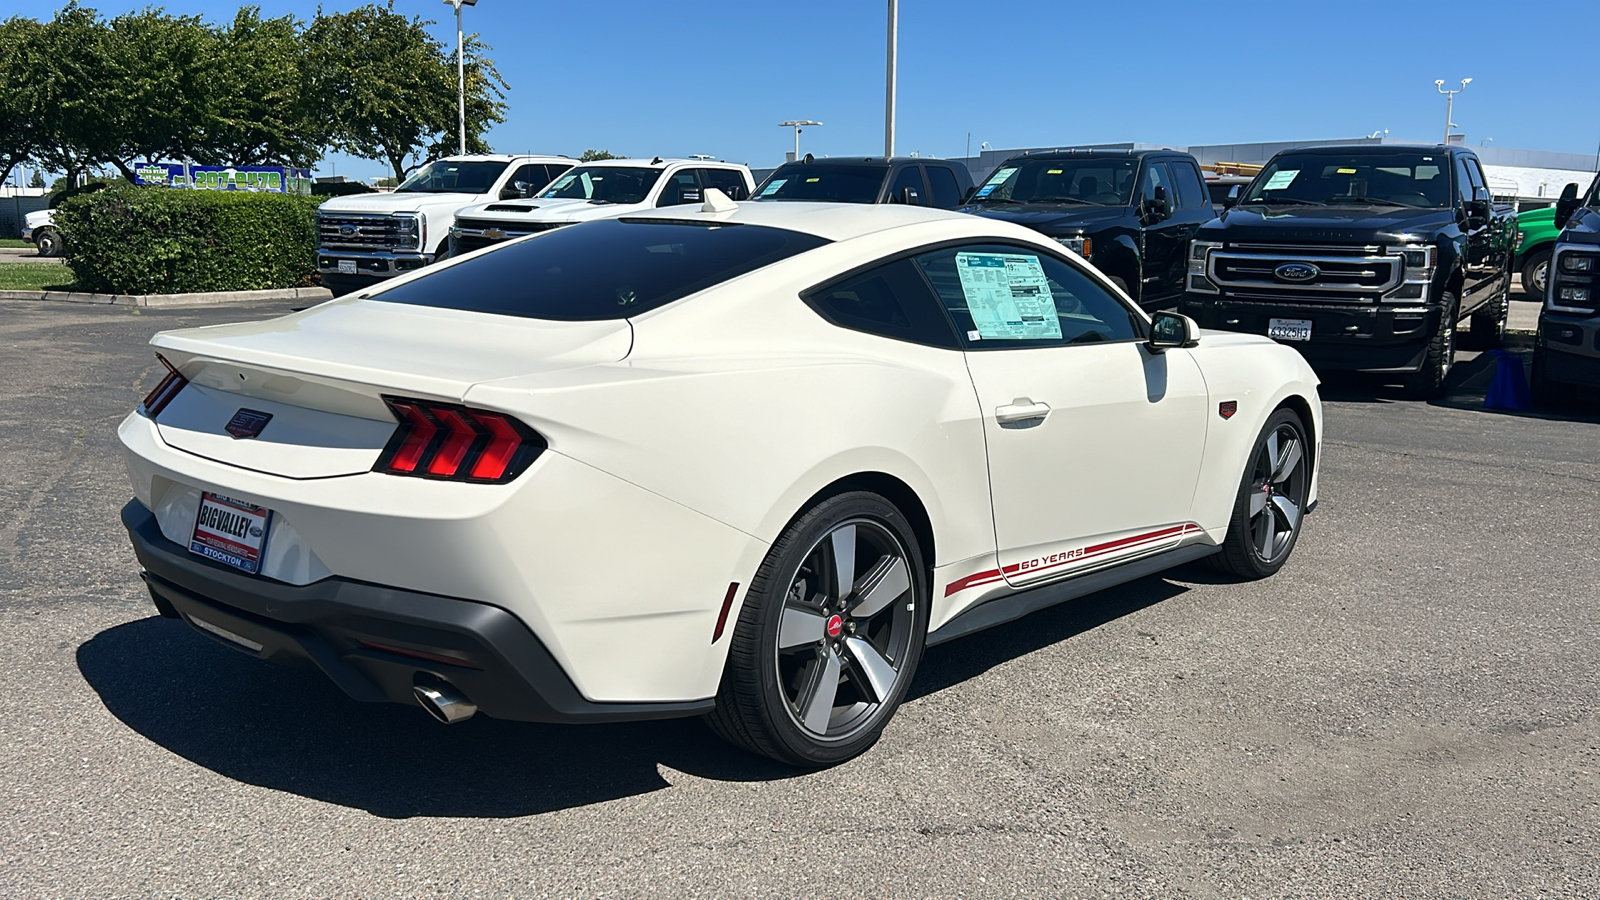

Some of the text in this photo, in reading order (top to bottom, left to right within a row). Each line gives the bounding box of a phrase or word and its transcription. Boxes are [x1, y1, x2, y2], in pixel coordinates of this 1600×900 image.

[1284, 267, 1307, 277] Ford
[1271, 326, 1308, 338] 63325H3
[200, 505, 252, 539] BIGVALLEY
[204, 547, 241, 566] STOCKTON
[1021, 548, 1083, 569] 60 YEARS
